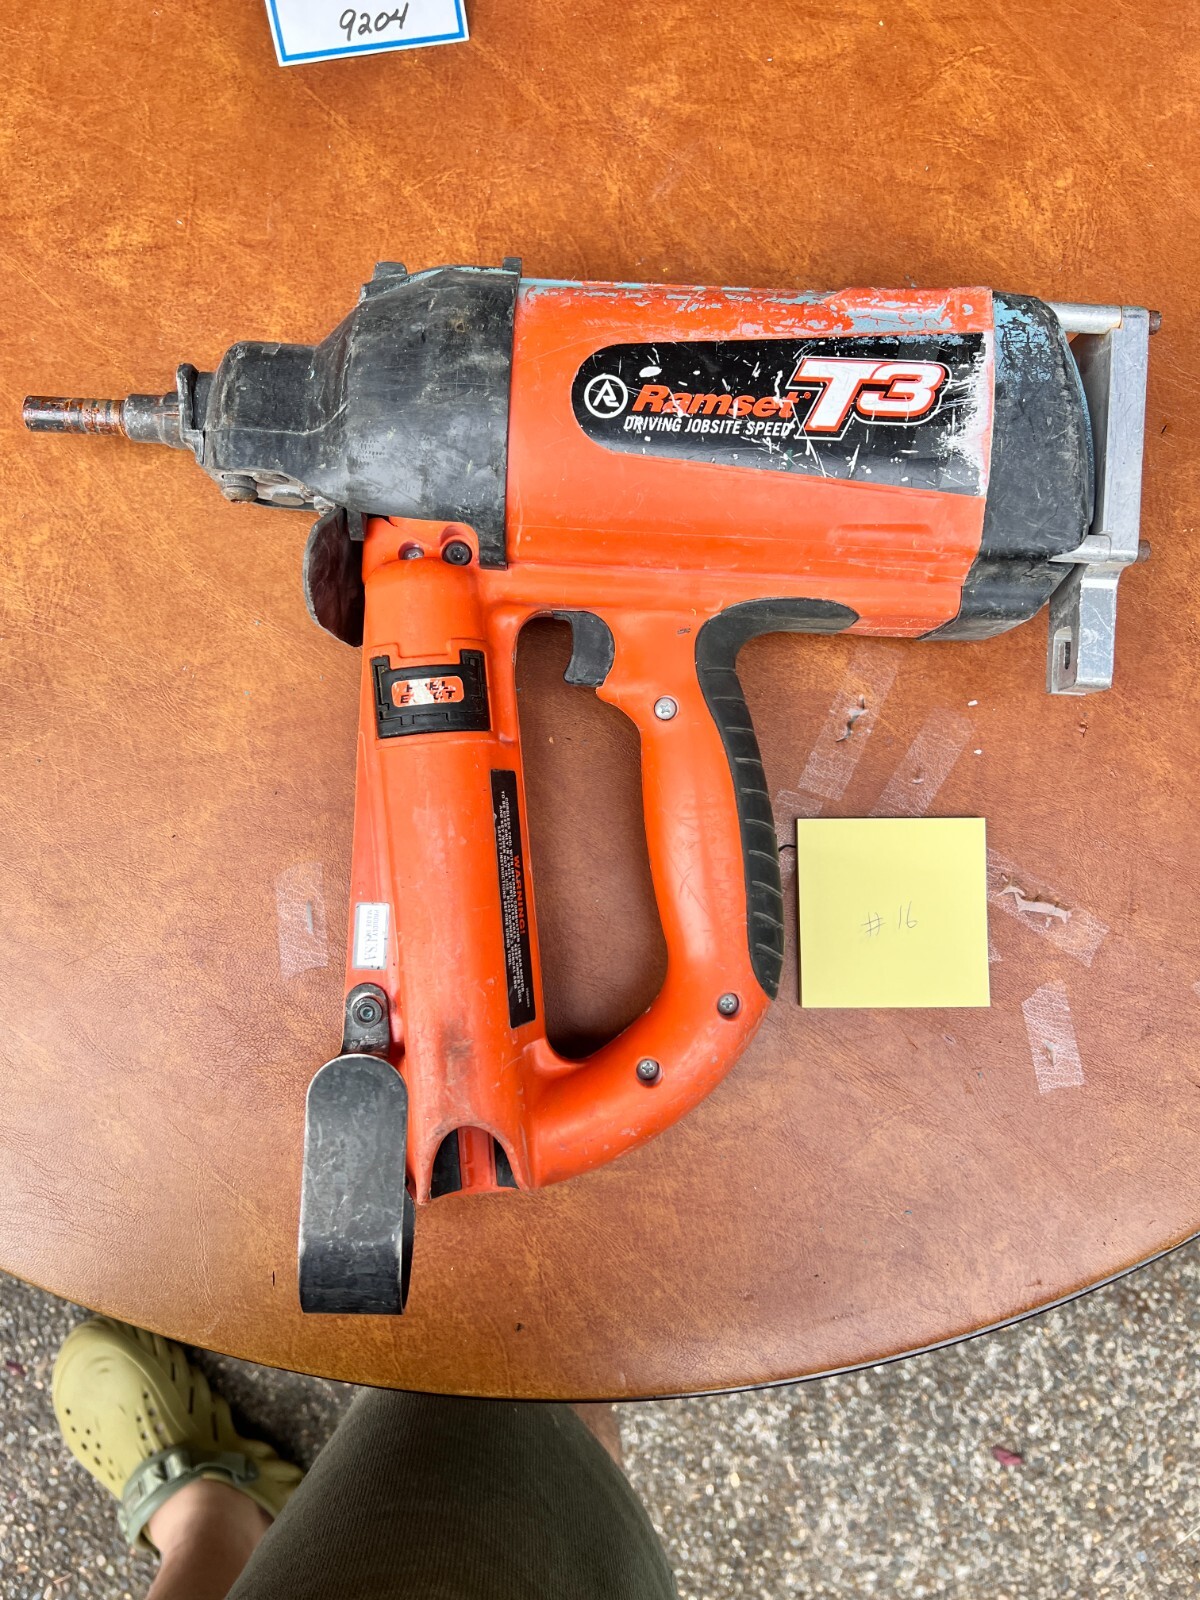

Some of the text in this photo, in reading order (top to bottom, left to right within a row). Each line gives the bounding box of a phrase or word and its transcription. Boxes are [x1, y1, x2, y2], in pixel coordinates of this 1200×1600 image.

[339, 2, 409, 42] 9204
[795, 358, 950, 440] T3
[623, 415, 791, 439] DRIVING JOBSITE SPEED
[513, 855, 525, 935] WARNING!
[898, 901, 918, 929] 16
